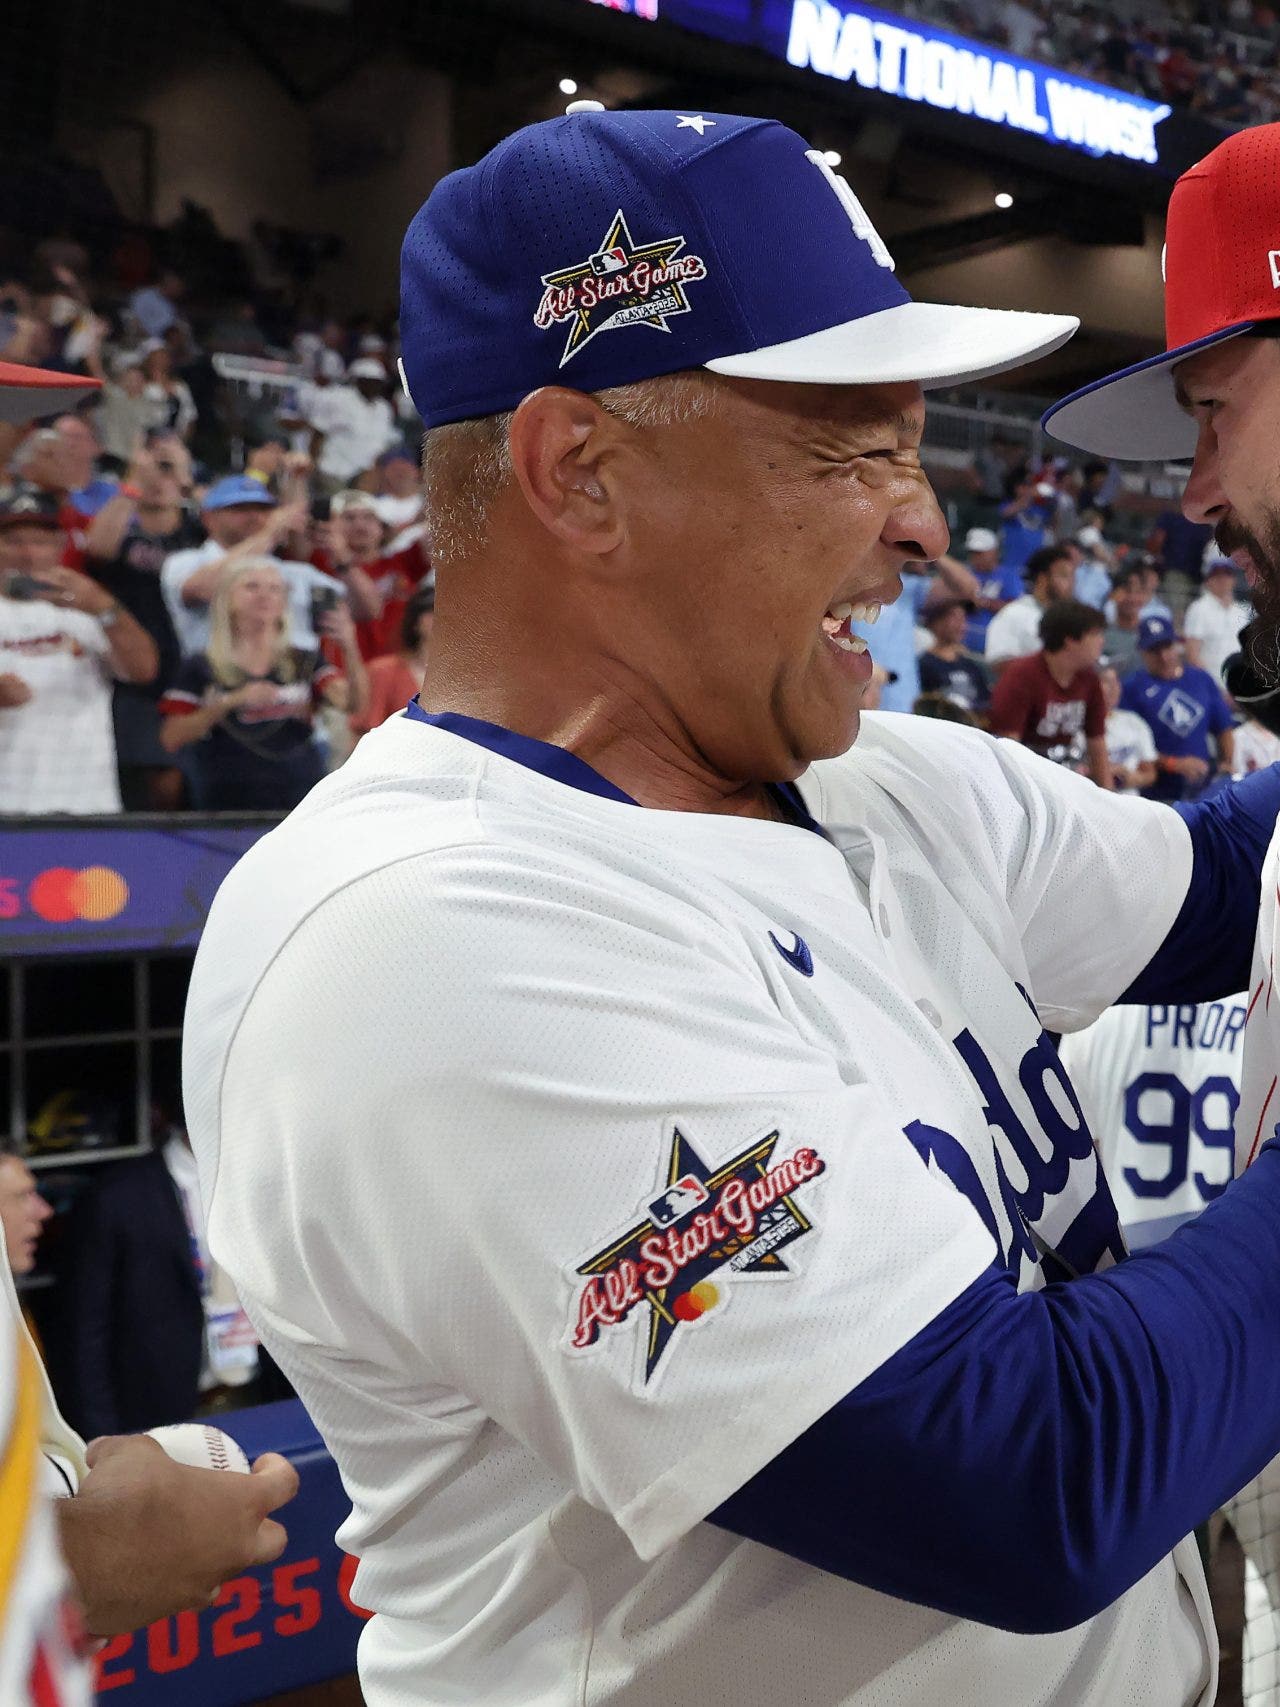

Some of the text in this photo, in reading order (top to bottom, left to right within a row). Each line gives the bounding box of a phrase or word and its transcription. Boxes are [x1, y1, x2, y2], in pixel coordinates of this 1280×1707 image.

[786, 0, 1048, 134] NATIONAL
[630, 257, 700, 296] Game
[1122, 1072, 1241, 1201] 99
[715, 1147, 824, 1235] Game
